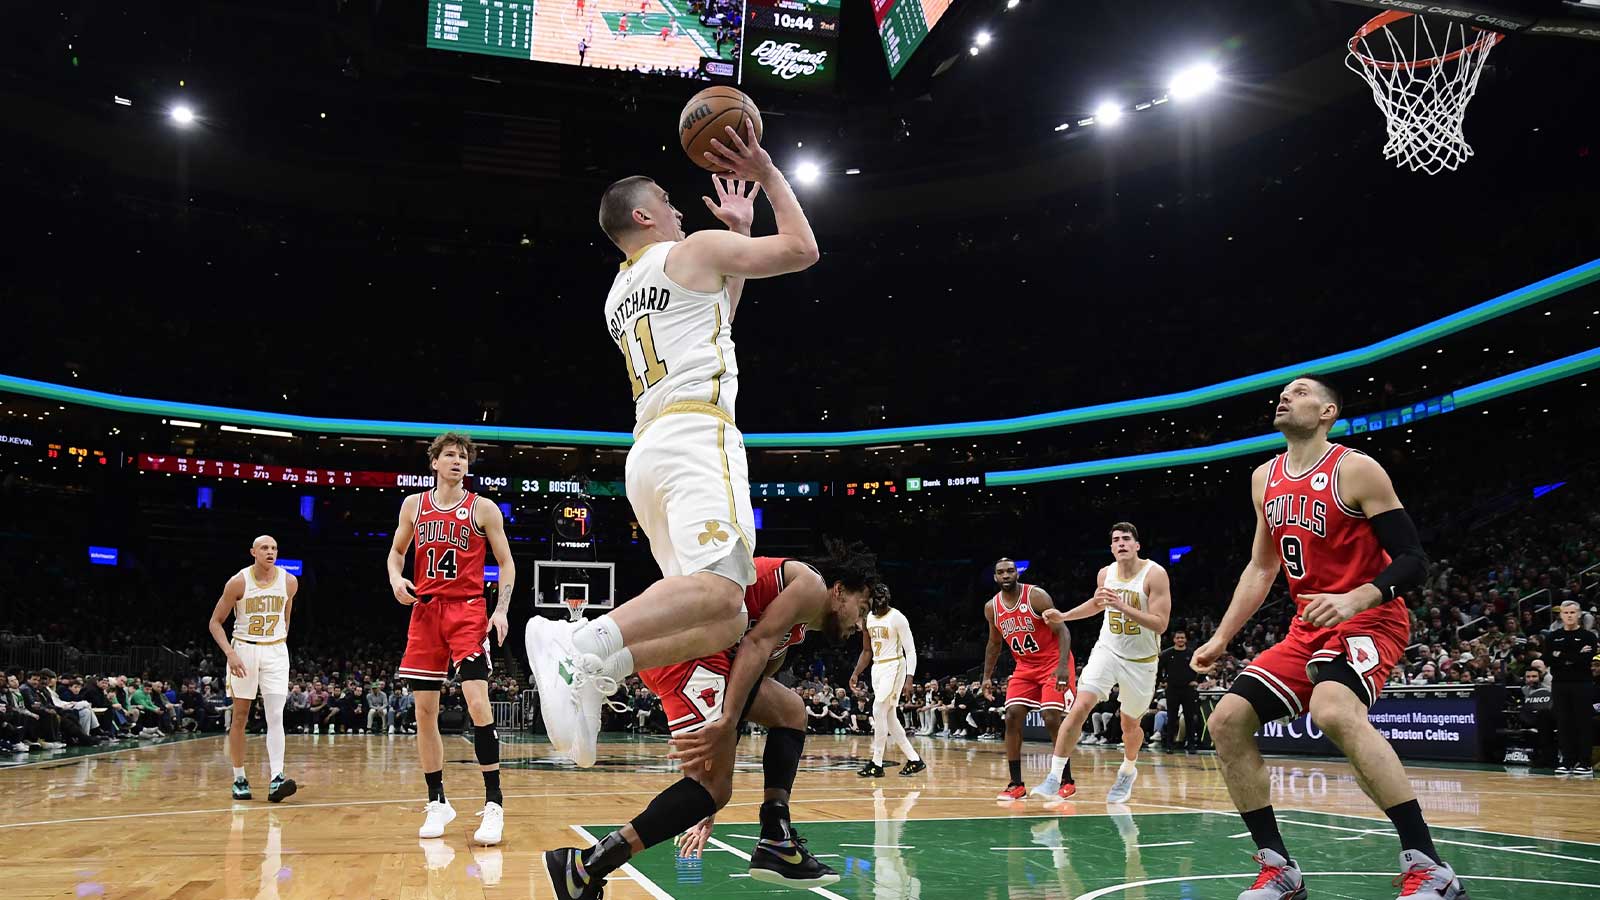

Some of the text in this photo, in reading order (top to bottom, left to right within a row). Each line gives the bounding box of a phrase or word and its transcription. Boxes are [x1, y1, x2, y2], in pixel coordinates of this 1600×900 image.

[774, 13, 835, 30] 10:44 2nd
[751, 40, 828, 66] Different
[771, 58, 817, 80] Here
[620, 313, 668, 402] 11
[397, 475, 435, 487] CHICAGO
[480, 477, 507, 486] 10:43
[521, 480, 540, 492] 33
[908, 480, 919, 489] TD
[966, 477, 980, 485] PM
[563, 507, 588, 518] 10:43
[1265, 494, 1327, 538] BULLS
[418, 520, 470, 551] BULLS
[574, 518, 585, 536] 7
[426, 547, 458, 580] 14
[1281, 535, 1306, 580] 9
[245, 595, 284, 614] BOSTON
[248, 614, 280, 636] 27
[1000, 615, 1035, 639] BULLS
[1108, 611, 1141, 635] 52
[874, 641, 882, 656] 7
[1011, 633, 1040, 656] 44
[1368, 713, 1475, 726] nvestment Management
[1391, 728, 1424, 740] Boston
[1425, 730, 1460, 741] Celtics
